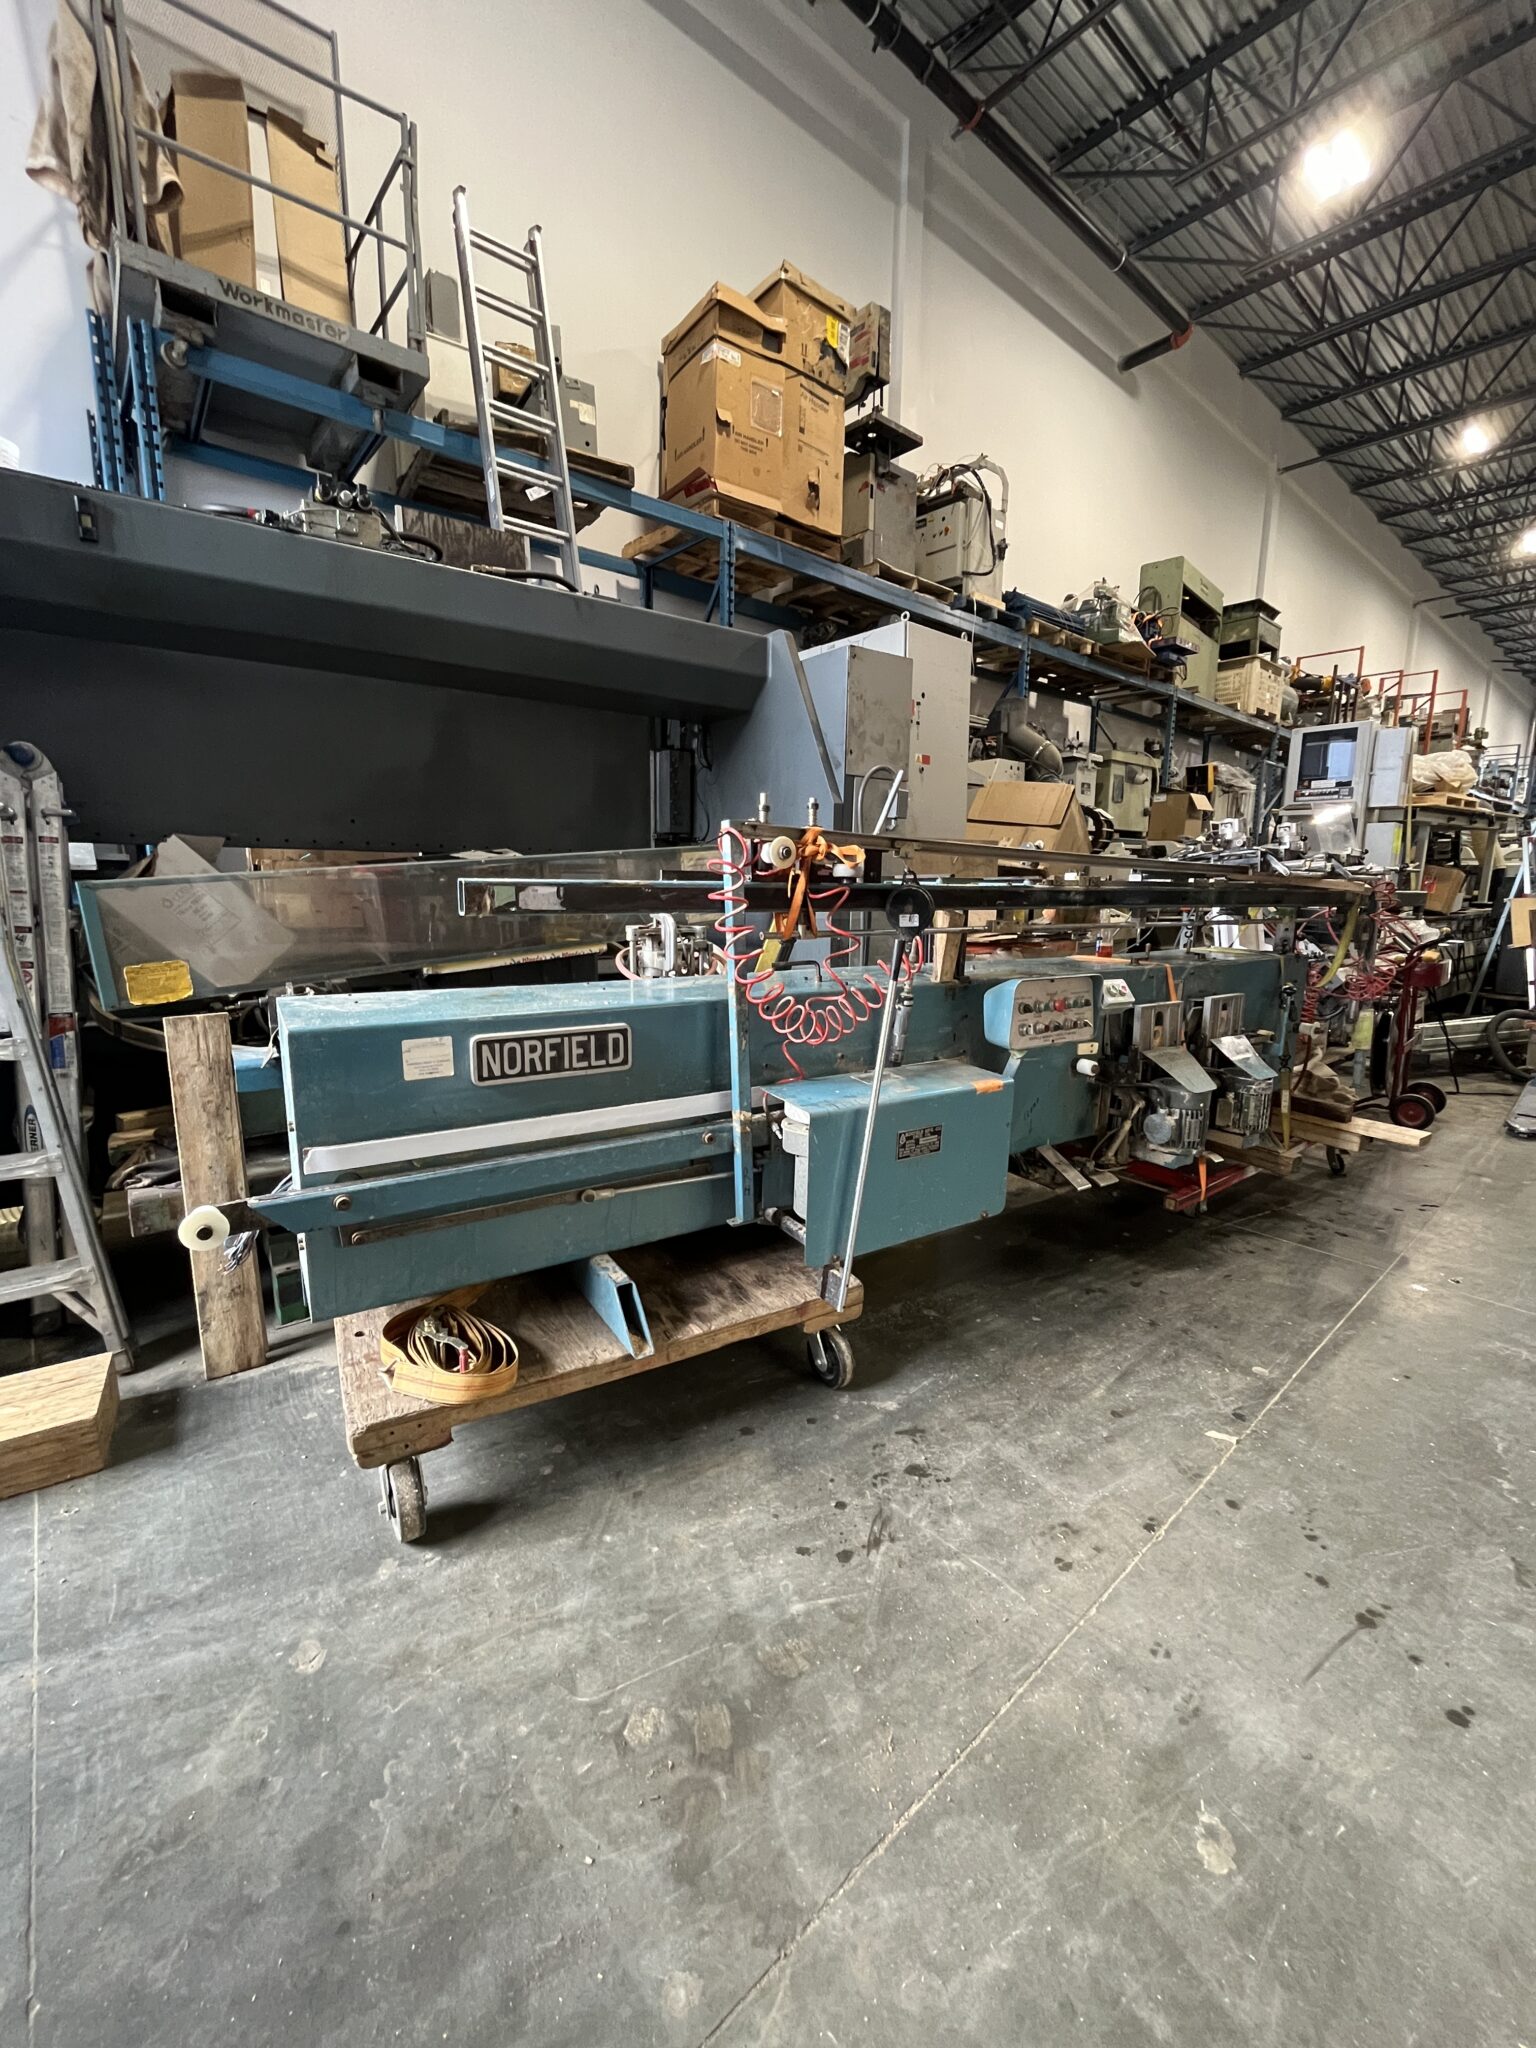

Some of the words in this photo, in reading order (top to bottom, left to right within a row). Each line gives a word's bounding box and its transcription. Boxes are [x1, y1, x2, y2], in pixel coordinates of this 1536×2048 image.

[217, 278, 347, 341] Workmaster
[481, 1032, 625, 1078] NORFIELD
[27, 1118, 39, 1152] ERNER
